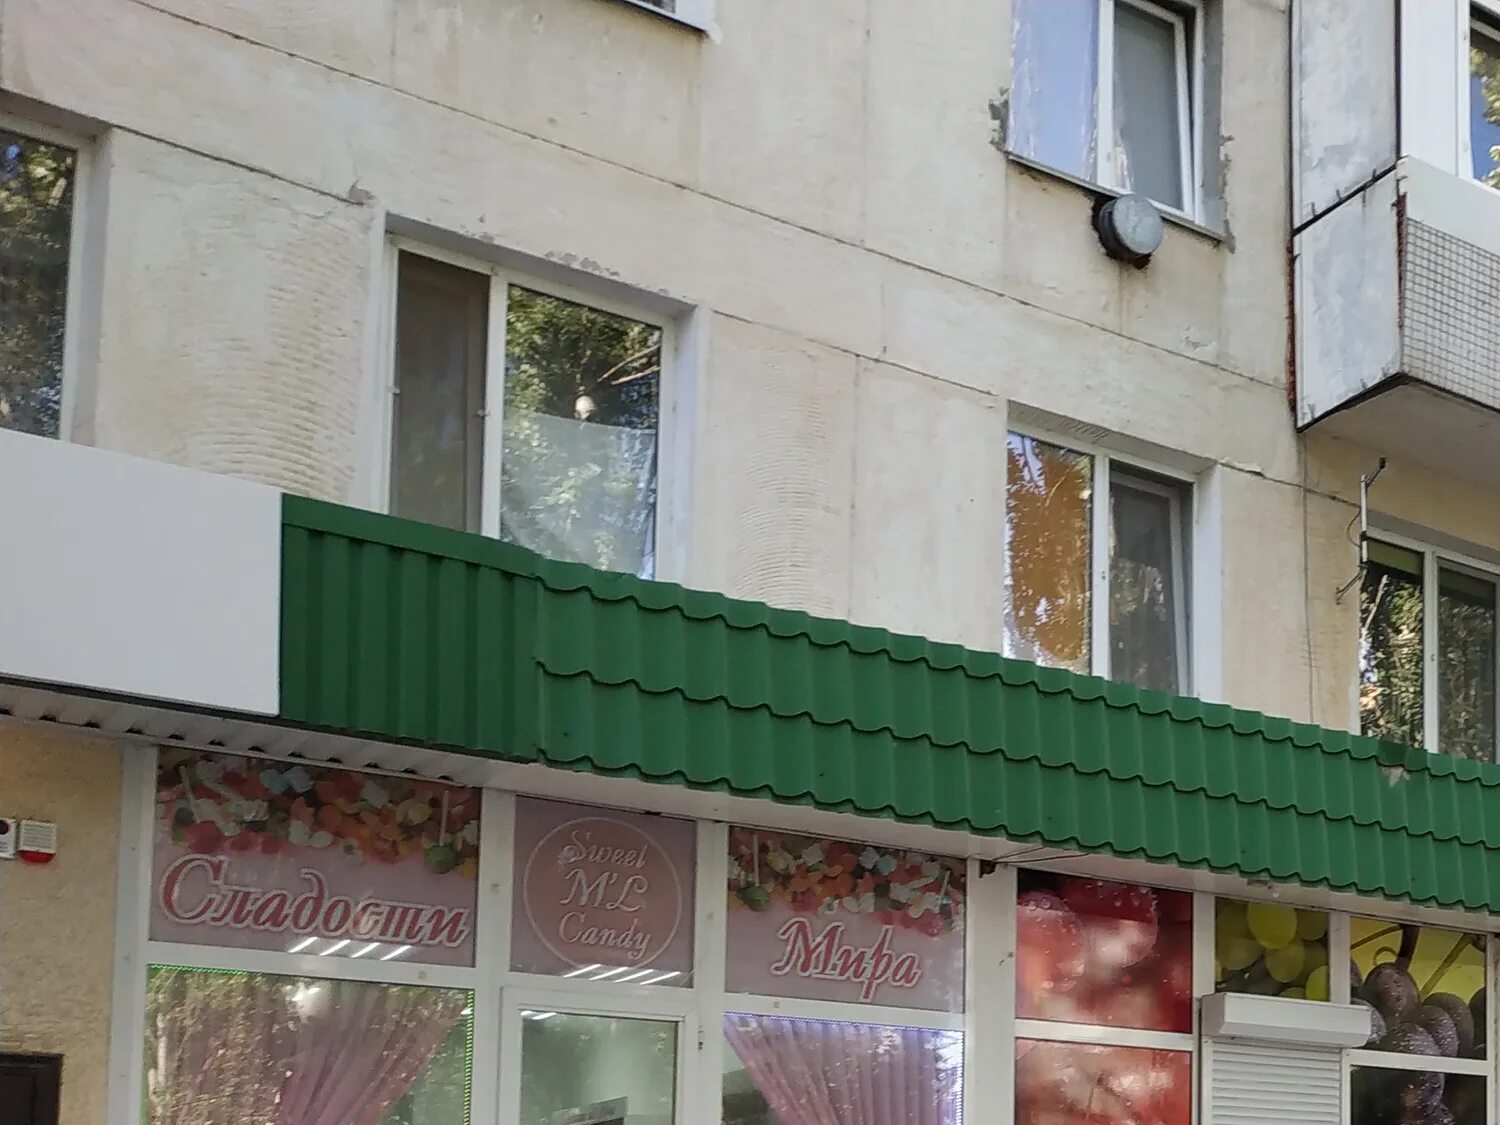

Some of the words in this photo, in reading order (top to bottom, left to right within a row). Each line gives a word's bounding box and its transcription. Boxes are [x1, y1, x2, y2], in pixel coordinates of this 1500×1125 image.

[558, 830, 649, 868] Sweet
[160, 853, 471, 948] Сладости
[558, 911, 651, 961] Candy
[770, 917, 922, 1003] Мира
